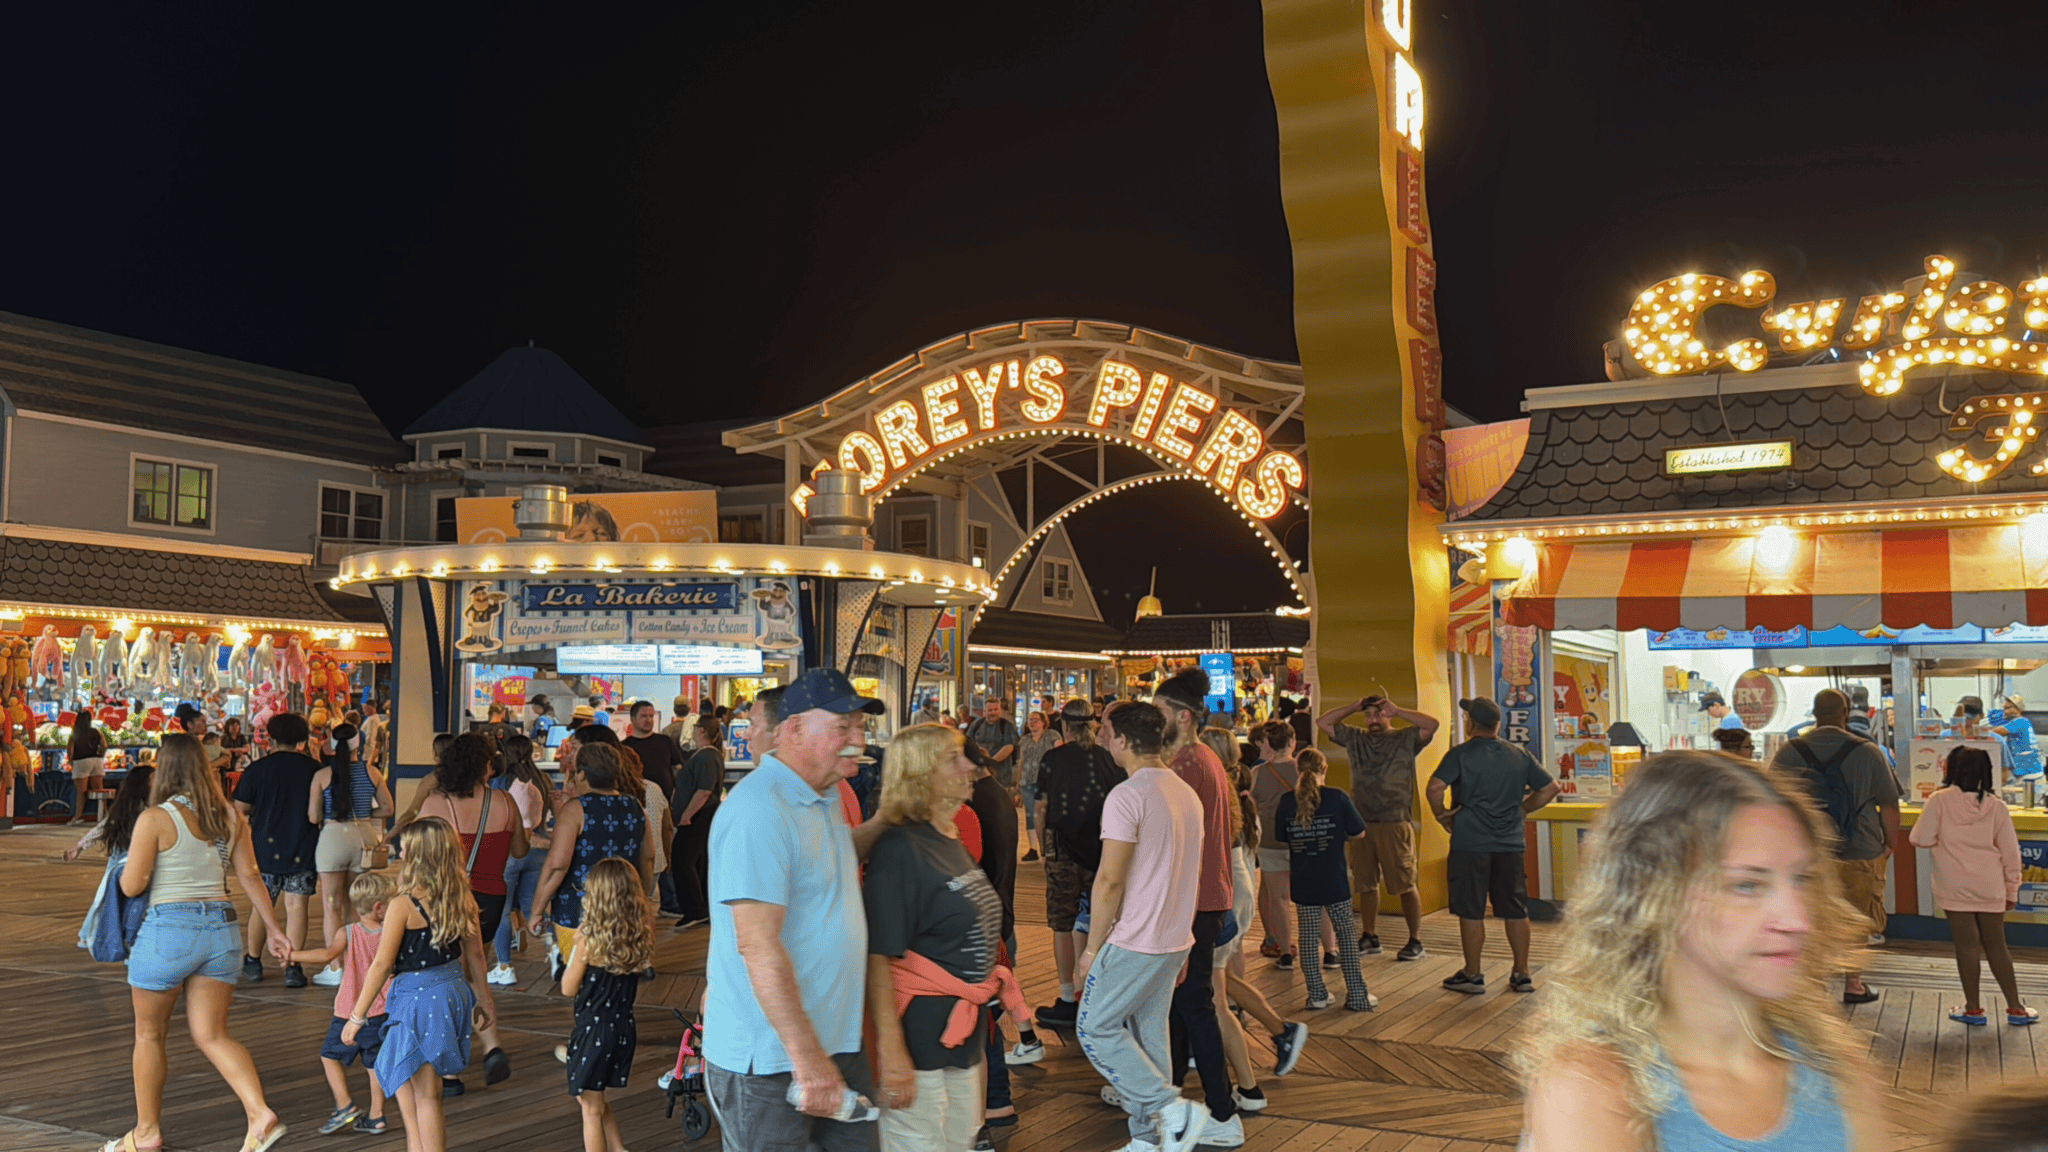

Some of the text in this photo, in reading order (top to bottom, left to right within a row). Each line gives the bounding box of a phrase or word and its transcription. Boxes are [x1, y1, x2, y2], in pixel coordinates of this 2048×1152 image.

[789, 354, 1304, 519] OREY'S PIERS
[1671, 447, 1786, 470] Established 1974
[1446, 434, 1529, 507] UMME
[540, 586, 718, 606] La Bakerie
[510, 618, 620, 636] Crepes Funnel Cakes
[638, 618, 749, 635] Cotton Candy Ice Cream
[926, 640, 941, 661] sh
